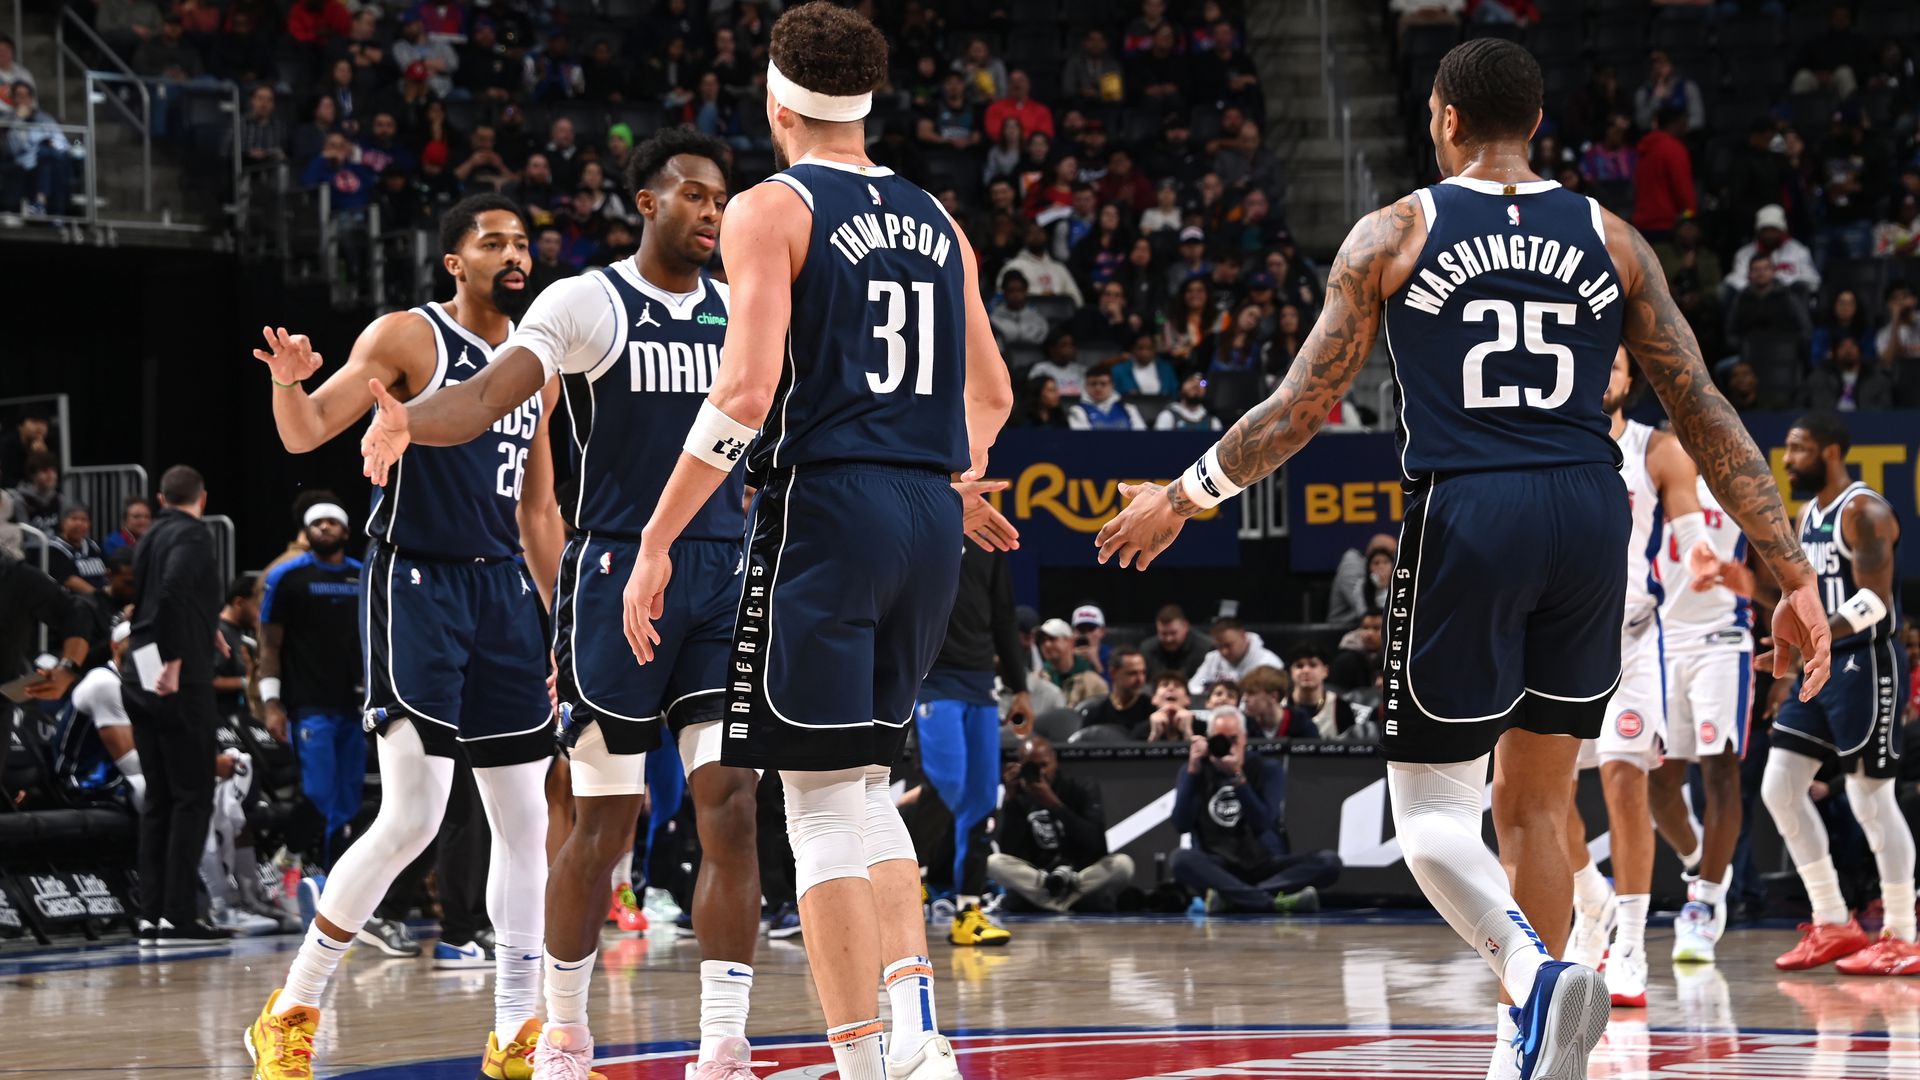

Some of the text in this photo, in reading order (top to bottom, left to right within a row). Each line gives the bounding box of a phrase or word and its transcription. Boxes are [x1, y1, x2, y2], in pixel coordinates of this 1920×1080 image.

[830, 213, 951, 267] THOMPSON
[1404, 234, 1619, 320] WASHINGTON JR.
[697, 312, 727, 326] chime
[865, 280, 934, 395] 31
[1462, 300, 1577, 409] 25
[629, 341, 724, 393] MAV
[728, 565, 765, 740] MAVERICKS
